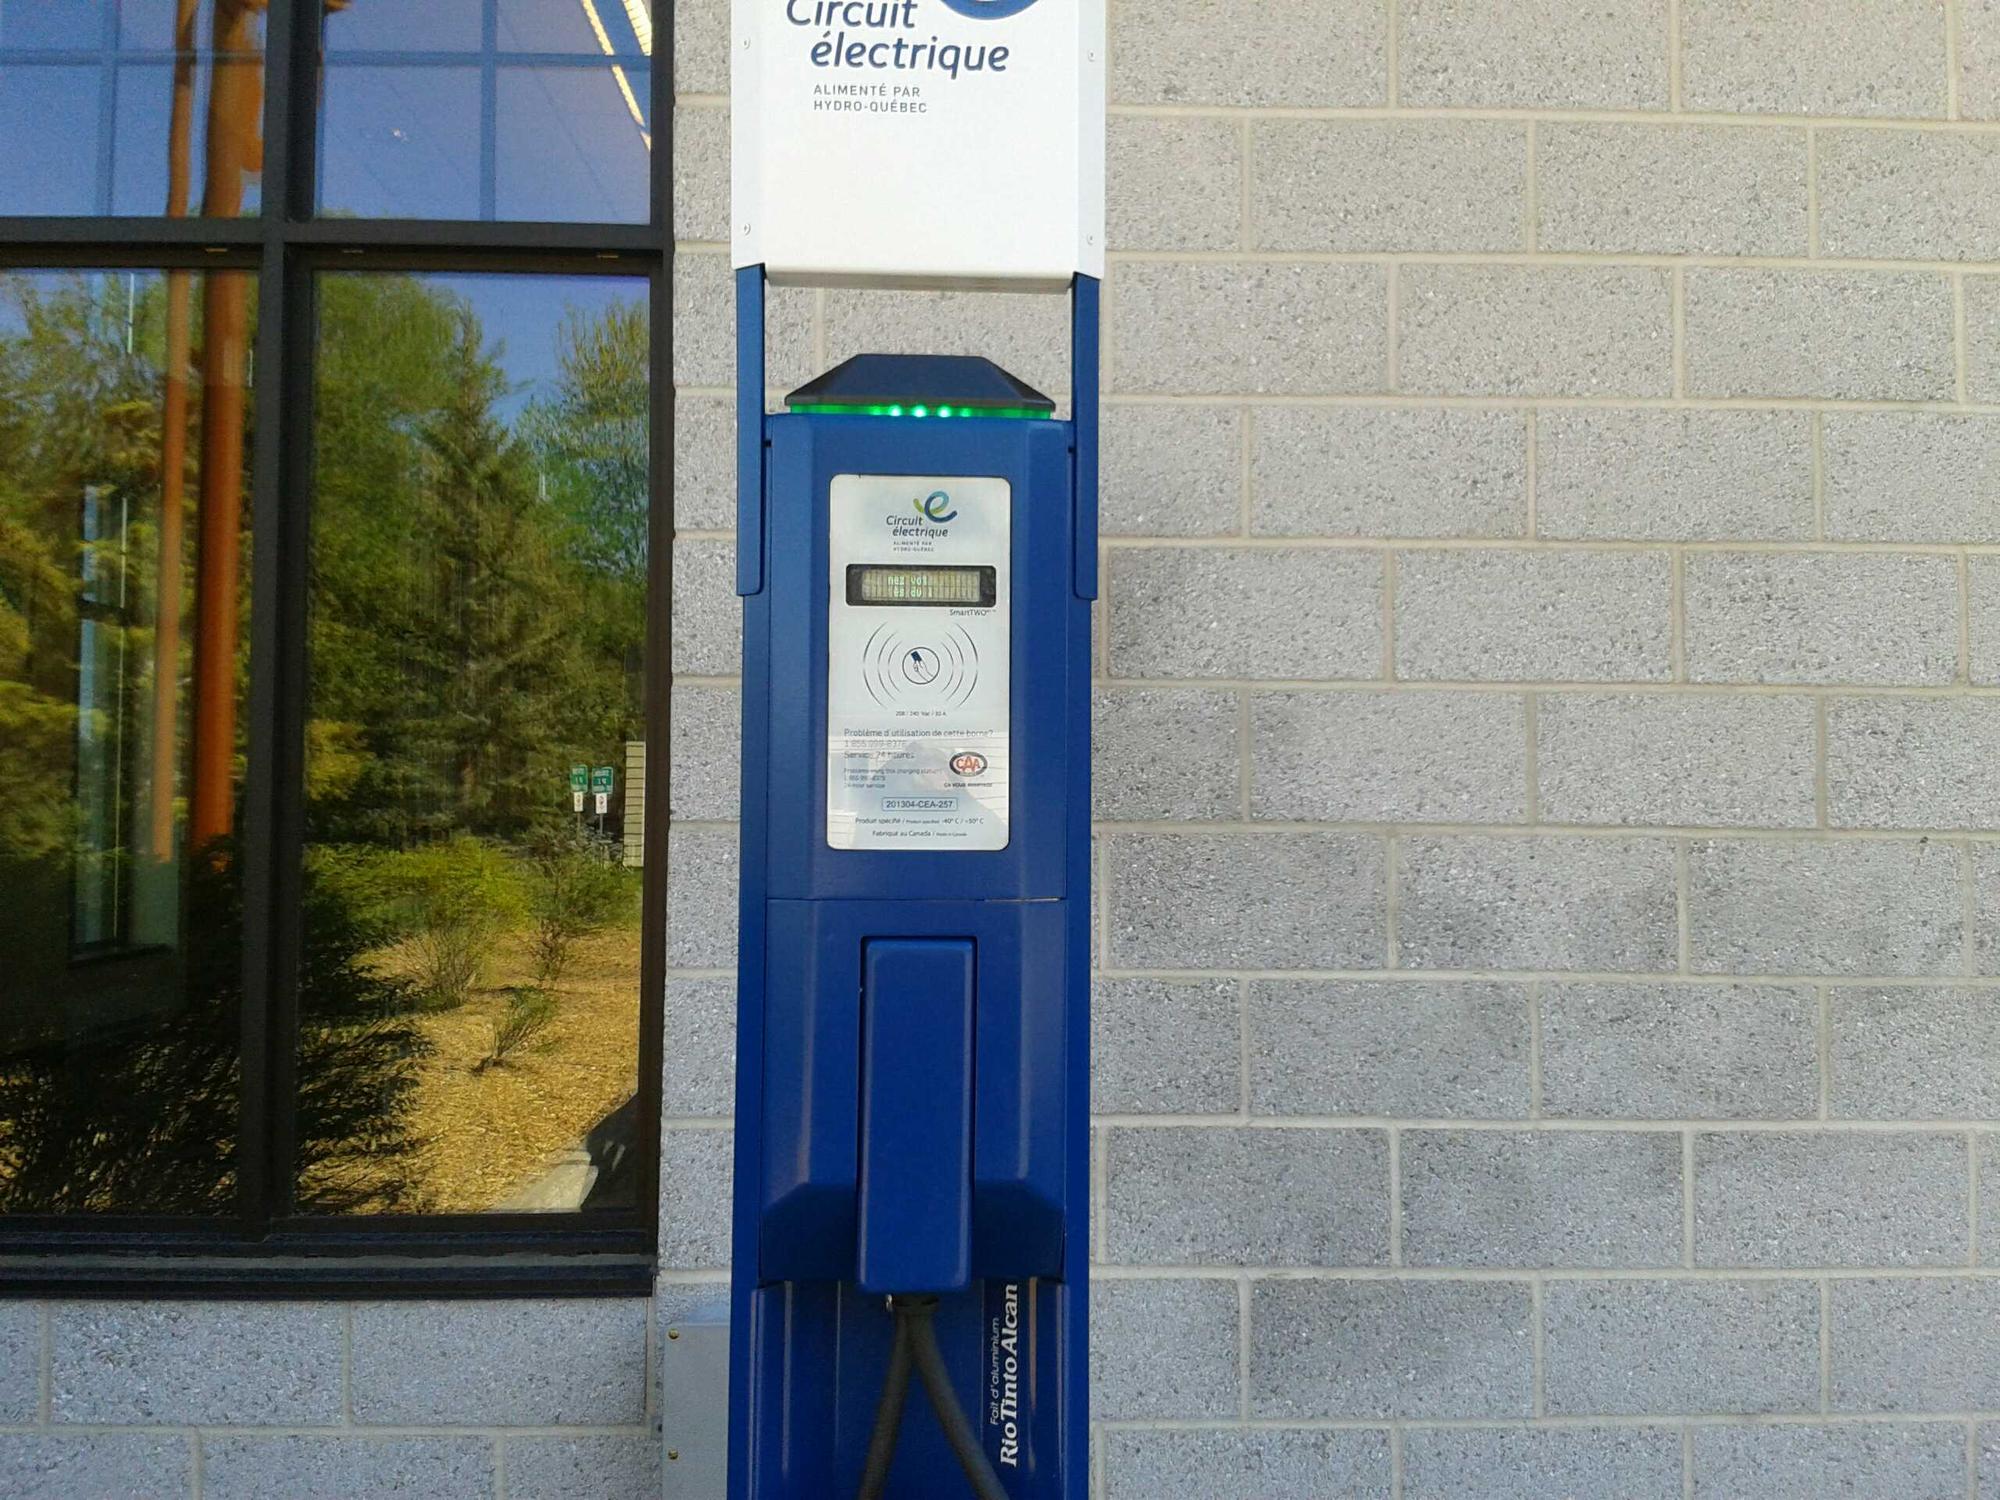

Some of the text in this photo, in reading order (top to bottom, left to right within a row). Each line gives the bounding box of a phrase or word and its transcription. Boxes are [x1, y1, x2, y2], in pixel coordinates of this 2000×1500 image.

[787, 0, 919, 28] Circuit
[811, 31, 1010, 80] électrique
[814, 83, 920, 97] ALIMENTÉ PAR
[814, 100, 927, 113] HYDRO-QUÉBEC
[886, 515, 923, 526] Circuit
[892, 526, 949, 539] électrique
[956, 756, 981, 771] CAA
[886, 800, 953, 808] 201304-CEA-257
[990, 1317, 999, 1426] Fait d'aluminium
